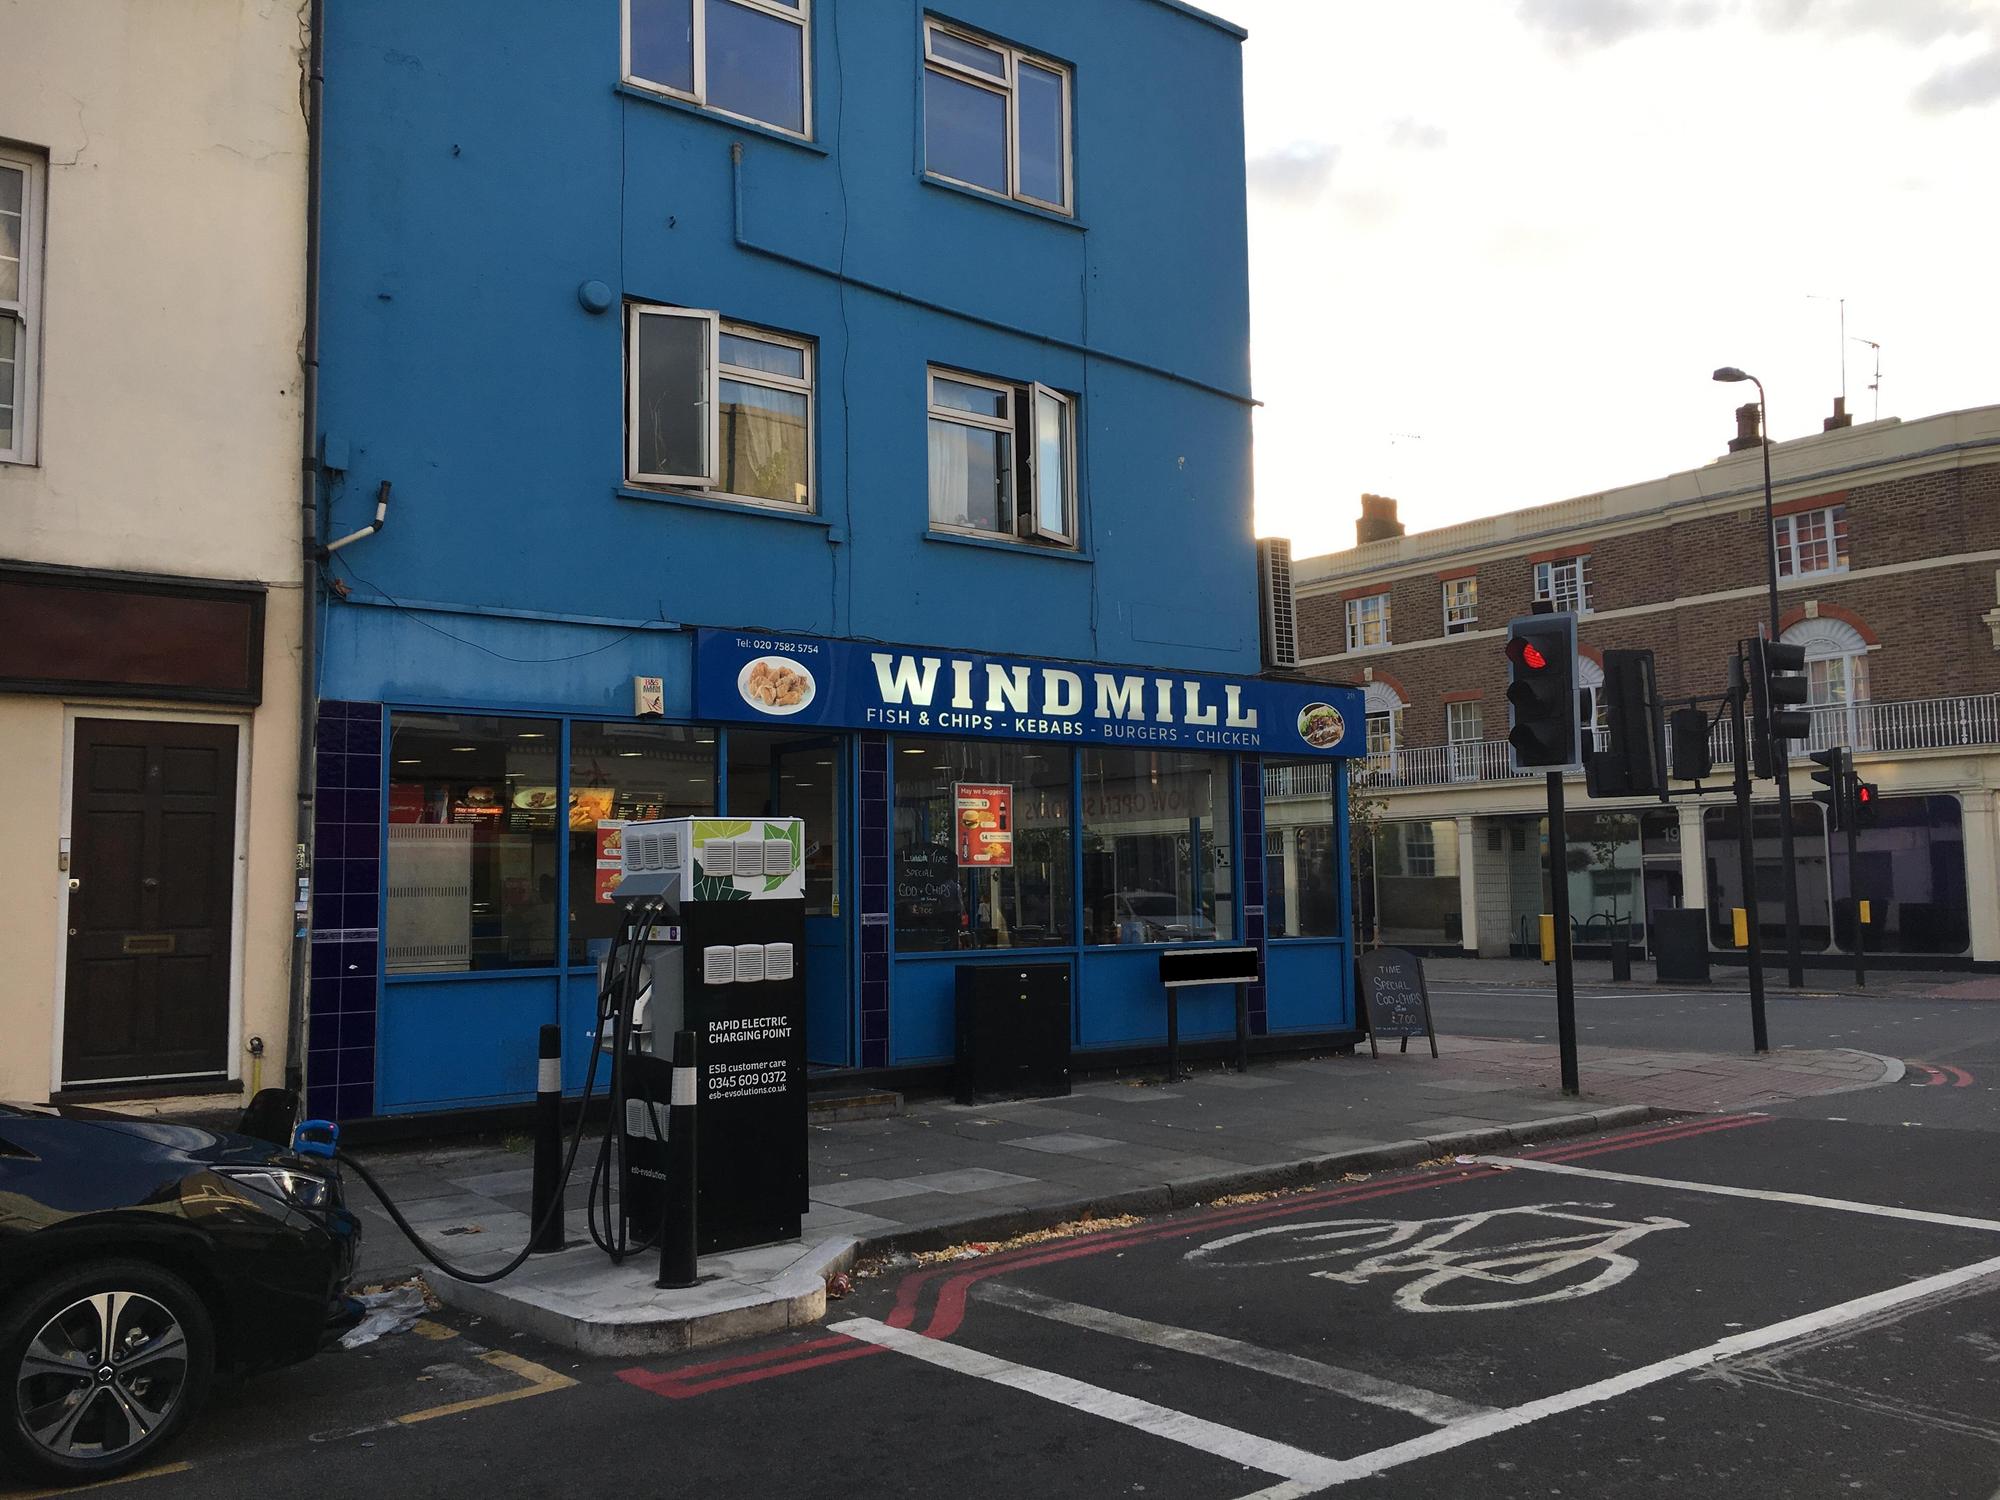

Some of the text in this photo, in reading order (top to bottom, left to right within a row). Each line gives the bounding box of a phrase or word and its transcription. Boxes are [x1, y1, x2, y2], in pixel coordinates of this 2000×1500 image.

[735, 638, 819, 654] Tel: 020 7582 5754
[871, 652, 1258, 728] WINDMILL
[866, 708, 910, 724] FISH
[918, 711, 930, 726] &
[938, 712, 993, 730] CHIPS
[1015, 718, 1083, 735] KEBABS
[1104, 724, 1177, 741] BURGERS
[1196, 730, 1260, 746] CHICKEN
[960, 787, 972, 796] May
[1662, 827, 1680, 842] 19
[1379, 965, 1401, 974] TIME
[709, 1016, 788, 1032] RAPID ELECTRIC
[708, 1027, 792, 1044] CHARGING POINT
[708, 1060, 787, 1074] ESB customer care
[708, 1070, 787, 1090] 0345 609 0372
[708, 1083, 787, 1100] esb-evsolutions.co.uk
